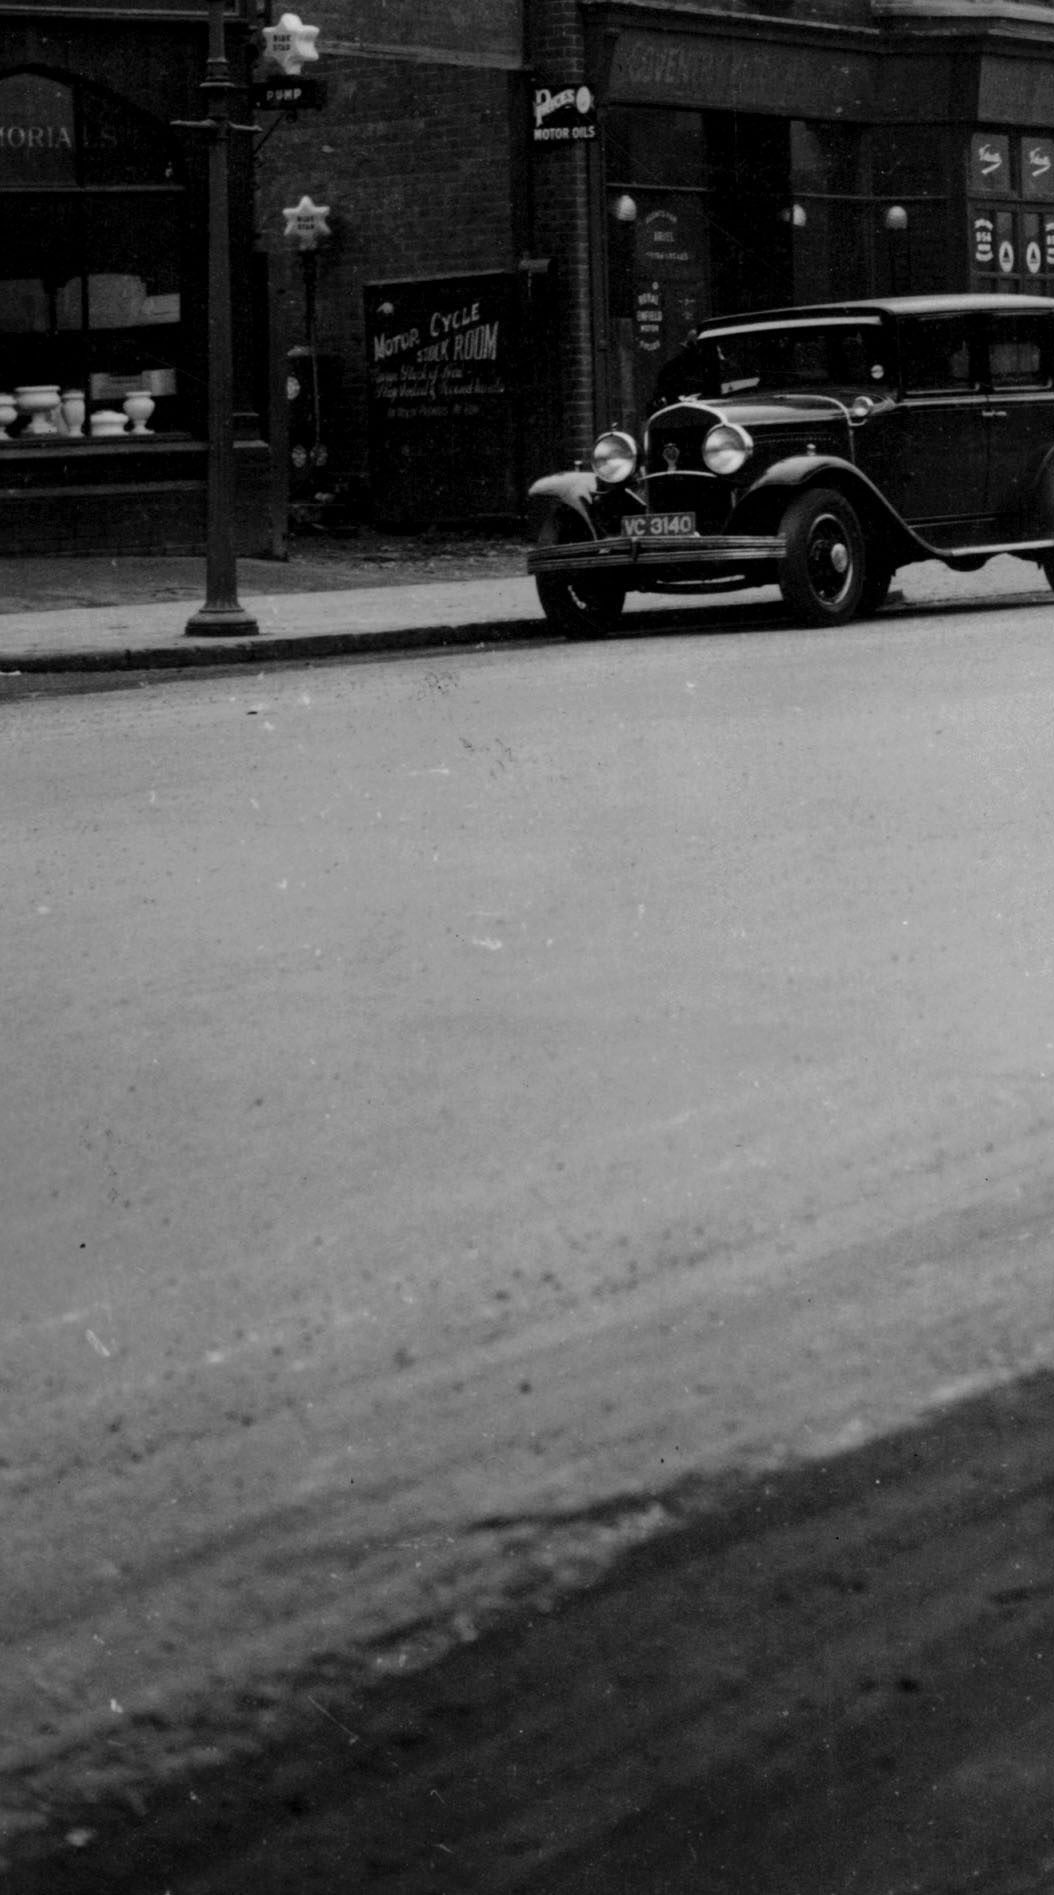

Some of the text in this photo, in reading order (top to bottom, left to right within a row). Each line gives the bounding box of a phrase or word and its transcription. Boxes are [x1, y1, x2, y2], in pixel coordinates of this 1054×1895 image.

[266, 88, 302, 102] PUMP
[533, 125, 596, 141] MOTOR OILS
[374, 302, 480, 362] MOTOR CYCLE
[453, 321, 500, 361] ROOM
[624, 516, 692, 536] VC 3140
